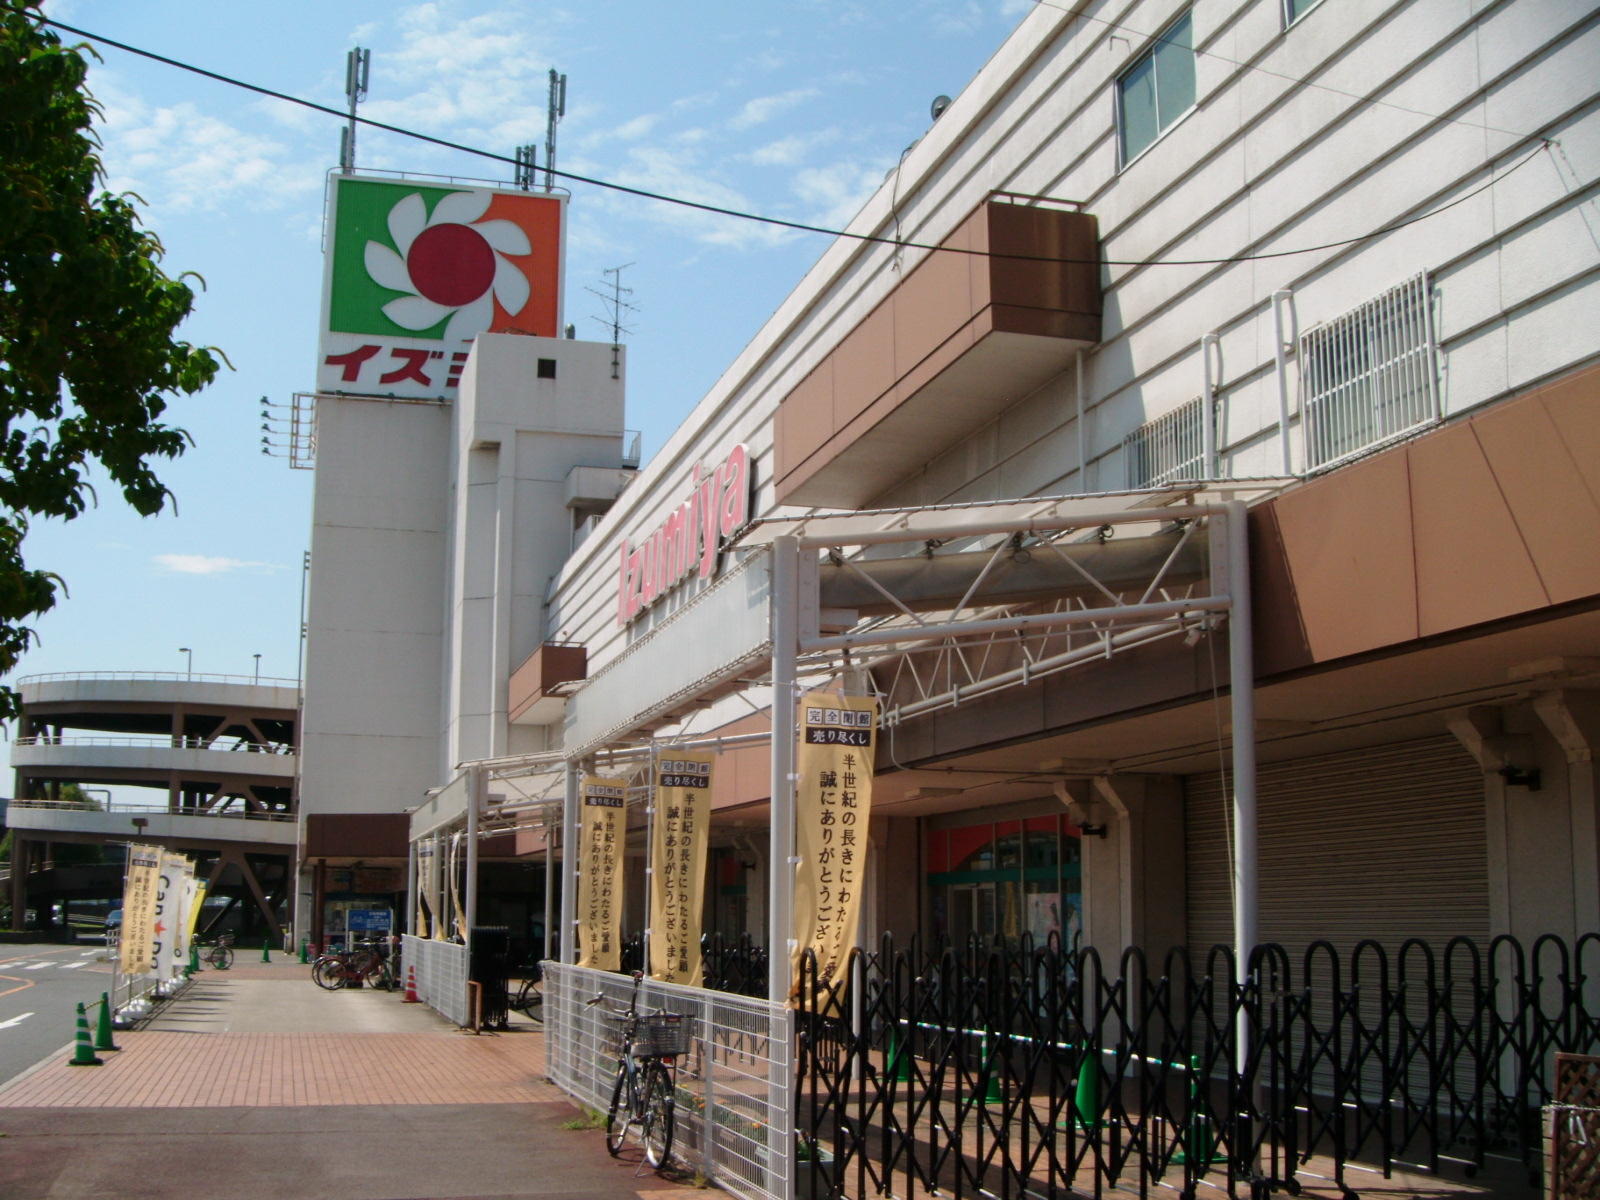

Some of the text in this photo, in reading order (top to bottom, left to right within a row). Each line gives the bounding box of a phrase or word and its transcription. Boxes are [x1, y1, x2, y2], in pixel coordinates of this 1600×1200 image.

[617, 443, 749, 626] Izumiya
[813, 730, 867, 745] 売り尽くし
